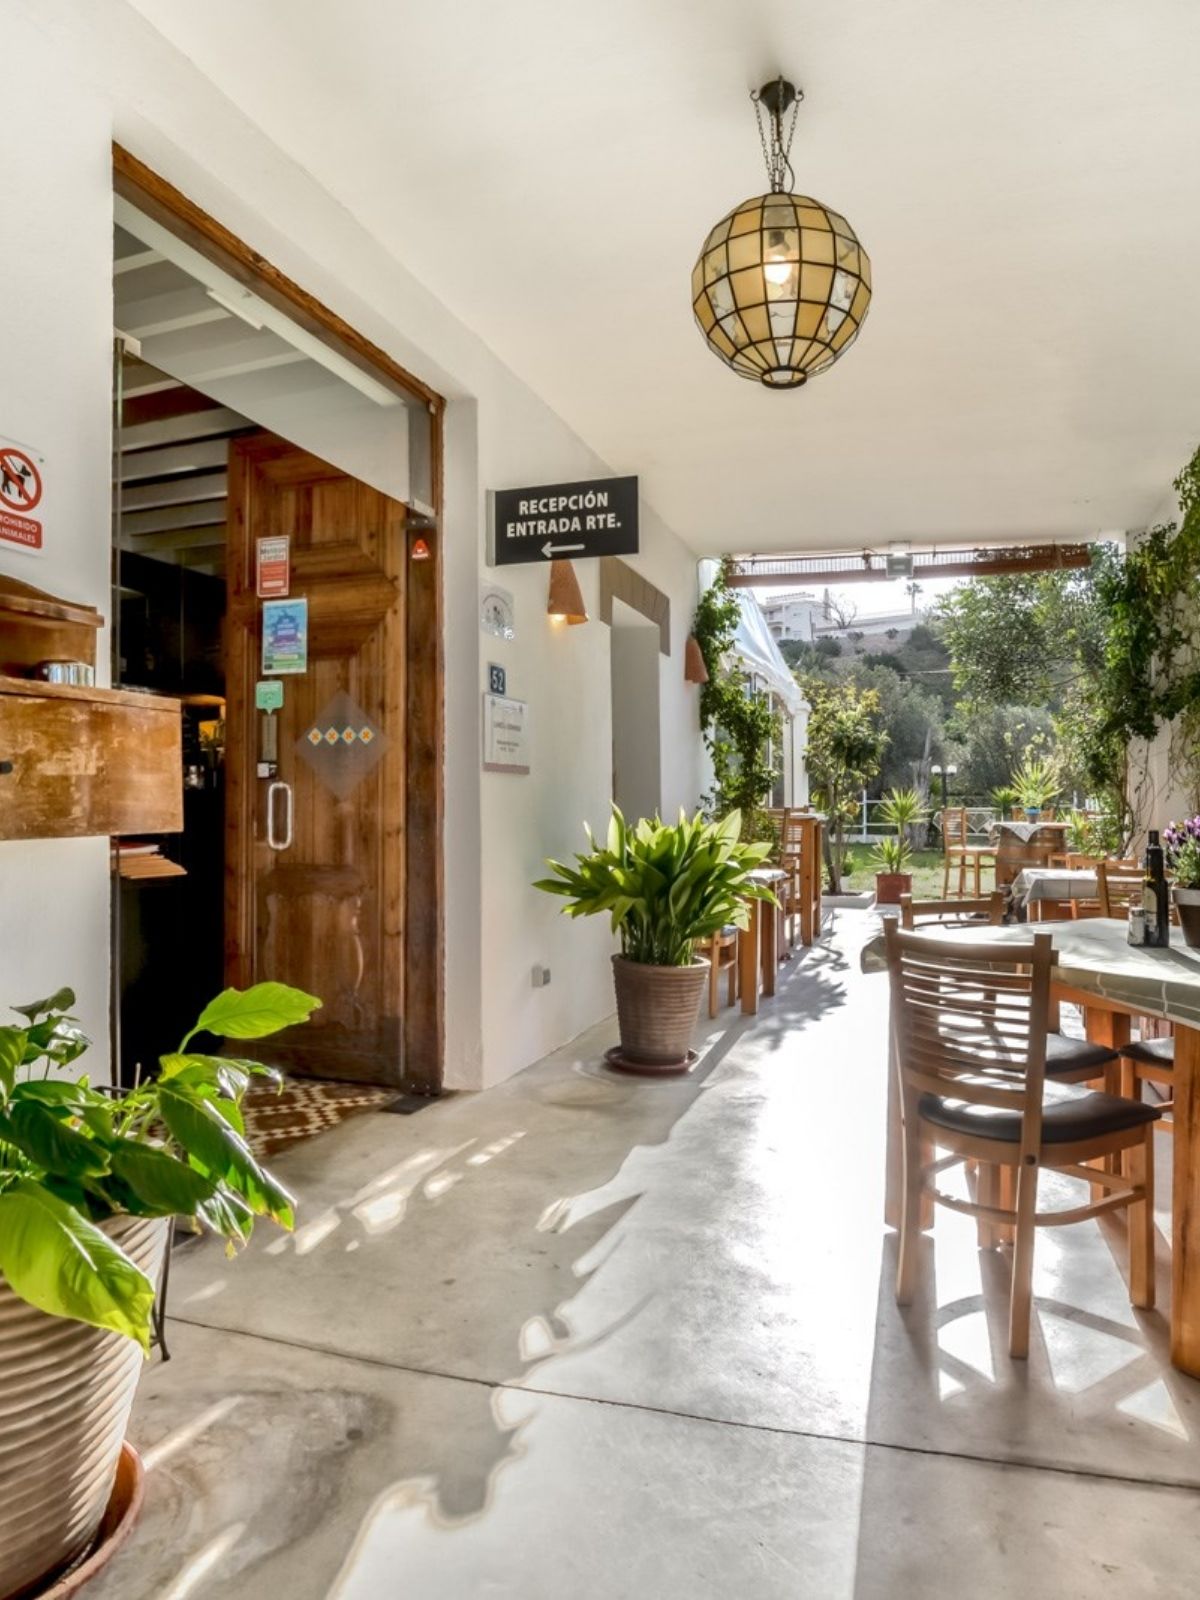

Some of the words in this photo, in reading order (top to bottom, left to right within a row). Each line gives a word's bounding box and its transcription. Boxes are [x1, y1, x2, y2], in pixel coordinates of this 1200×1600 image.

[519, 491, 608, 516] RECEPCIÓN
[506, 517, 581, 538] ENTRADA
[586, 513, 621, 531] RTE.
